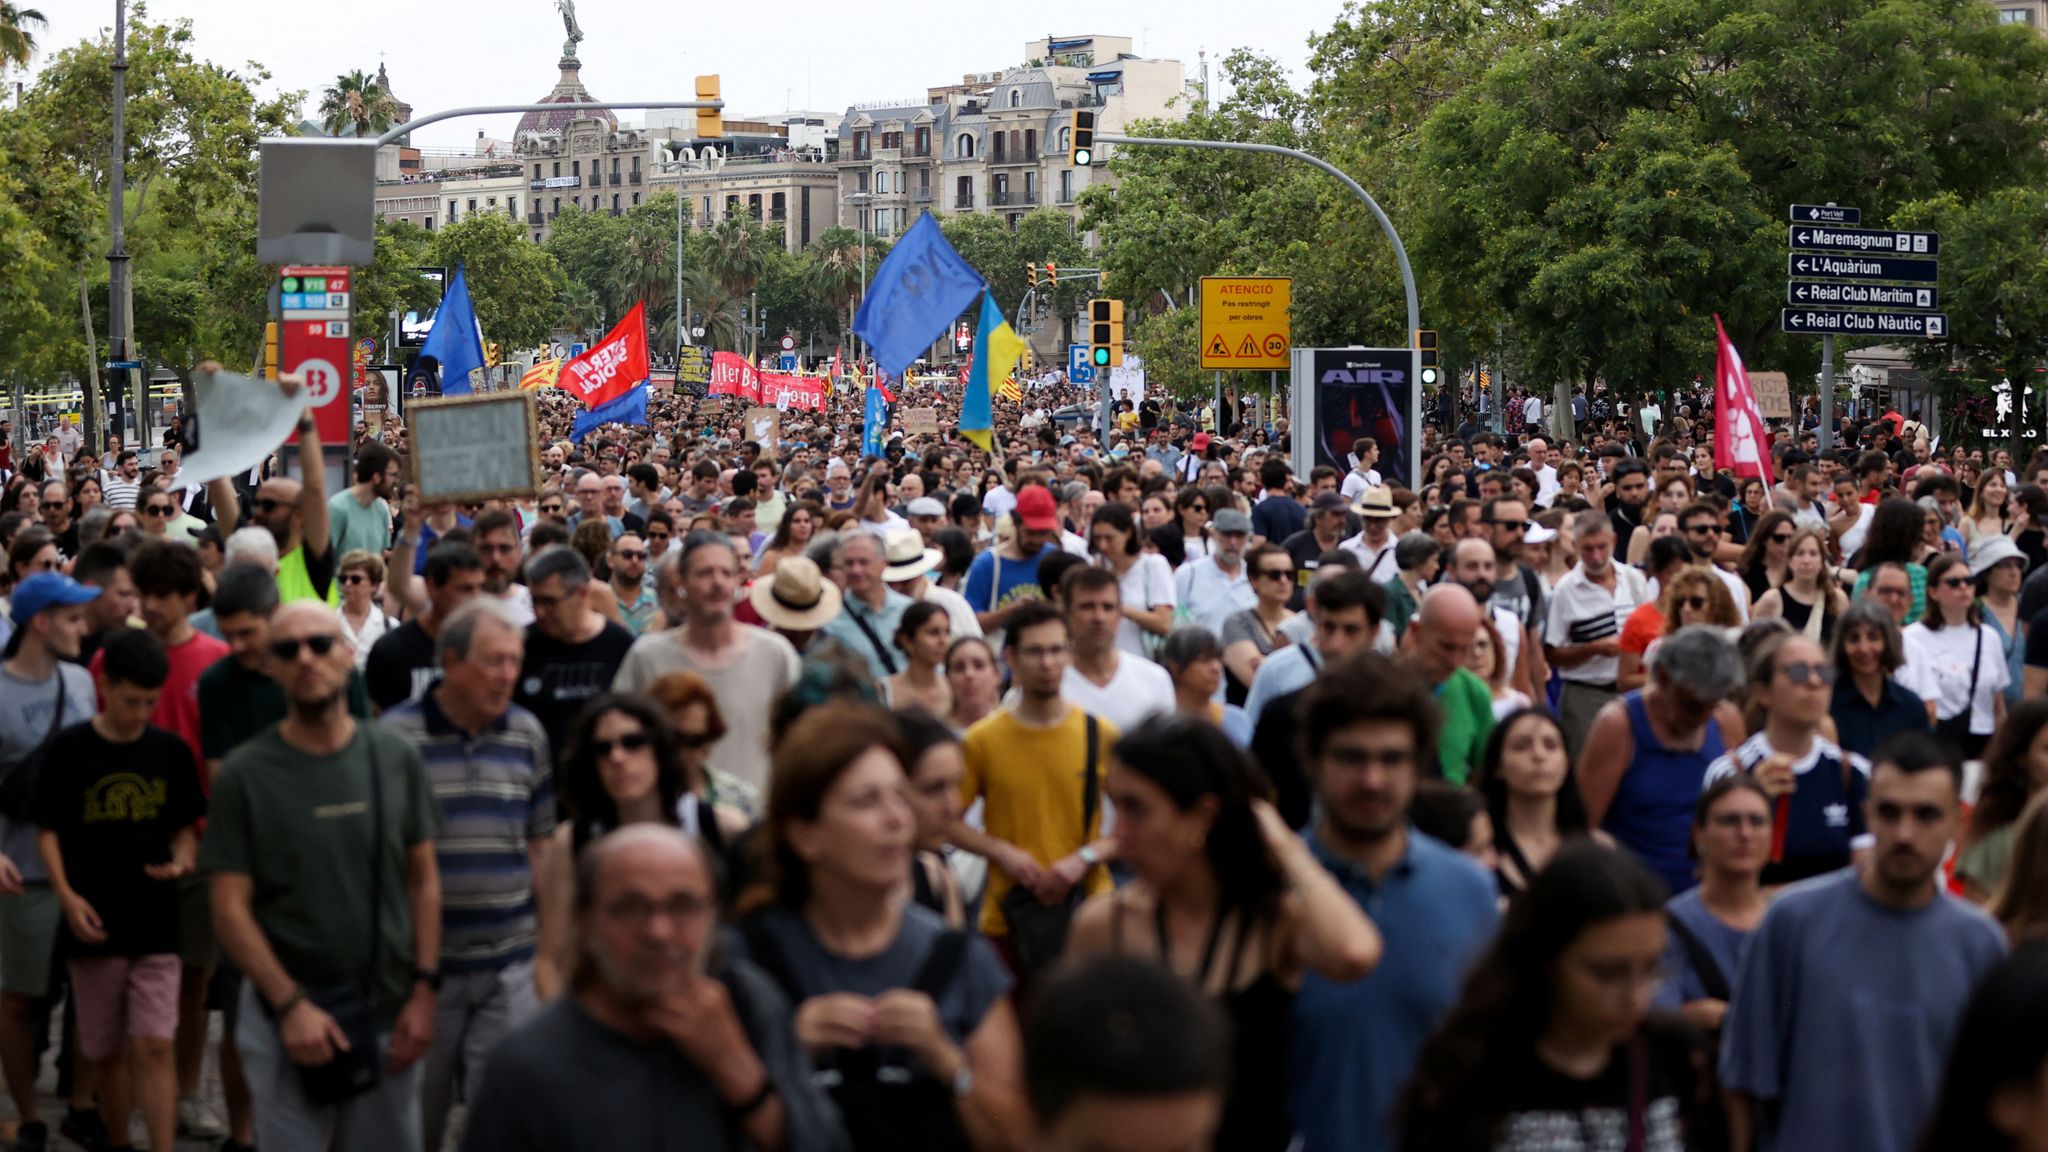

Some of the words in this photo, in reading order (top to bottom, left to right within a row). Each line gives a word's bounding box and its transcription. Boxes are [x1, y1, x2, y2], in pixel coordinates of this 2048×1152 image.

[1821, 209, 1832, 217] Port
[1833, 210, 1844, 218] Vell
[1812, 229, 1893, 250] Maremagnum
[1811, 257, 1882, 275] L'Aquàrium
[330, 280, 344, 291] 47
[1220, 283, 1274, 295] ATENCIÓ
[1811, 285, 1840, 300] Reial
[1842, 286, 1868, 302] Club
[1870, 287, 1913, 303] Marítim
[1222, 300, 1236, 308] Pas
[1238, 300, 1270, 309] restringit
[1806, 313, 1840, 328] Reial
[1844, 314, 1875, 329] Club
[1878, 315, 1922, 331] Nàutic
[1268, 342, 1282, 350] 30
[1074, 347, 1090, 370] P
[1321, 369, 1405, 383] AIR
[1983, 429, 1998, 438] EL
